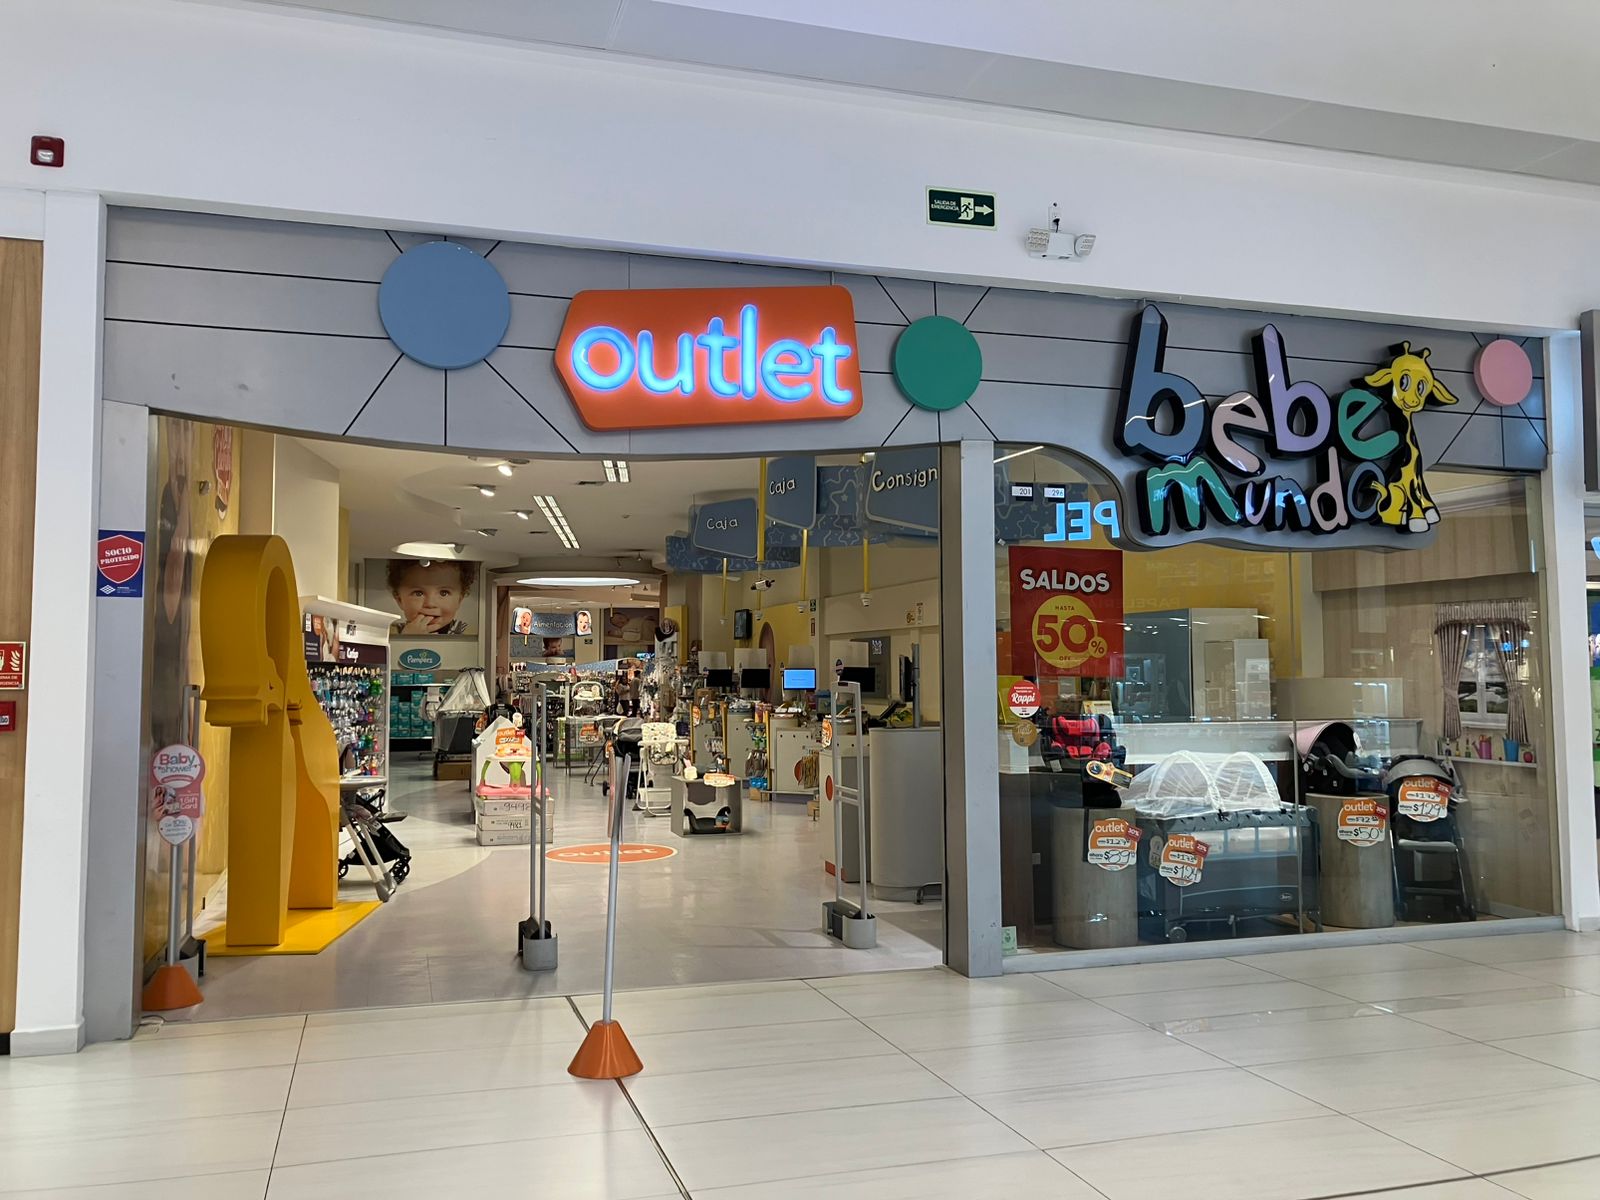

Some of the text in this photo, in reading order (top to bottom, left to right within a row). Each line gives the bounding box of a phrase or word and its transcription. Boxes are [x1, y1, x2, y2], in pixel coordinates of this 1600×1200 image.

[571, 303, 853, 405] outlet
[1117, 304, 1402, 478] bebe
[769, 477, 796, 495] Caja
[1138, 448, 1386, 540] mundo
[706, 518, 738, 534] Caja
[104, 546, 132, 558] SOCIO
[100, 553, 140, 566] PROTEGIDO
[1020, 568, 1110, 593] SALDOS
[407, 655, 433, 664] Pampers
[1011, 692, 1036, 705] Rappi
[160, 752, 195, 766] Baby
[161, 764, 192, 774] shower
[1404, 778, 1435, 789] outlet
[1344, 801, 1374, 812] outlet
[1095, 822, 1125, 833] outlet
[1168, 837, 1195, 850] outlet
